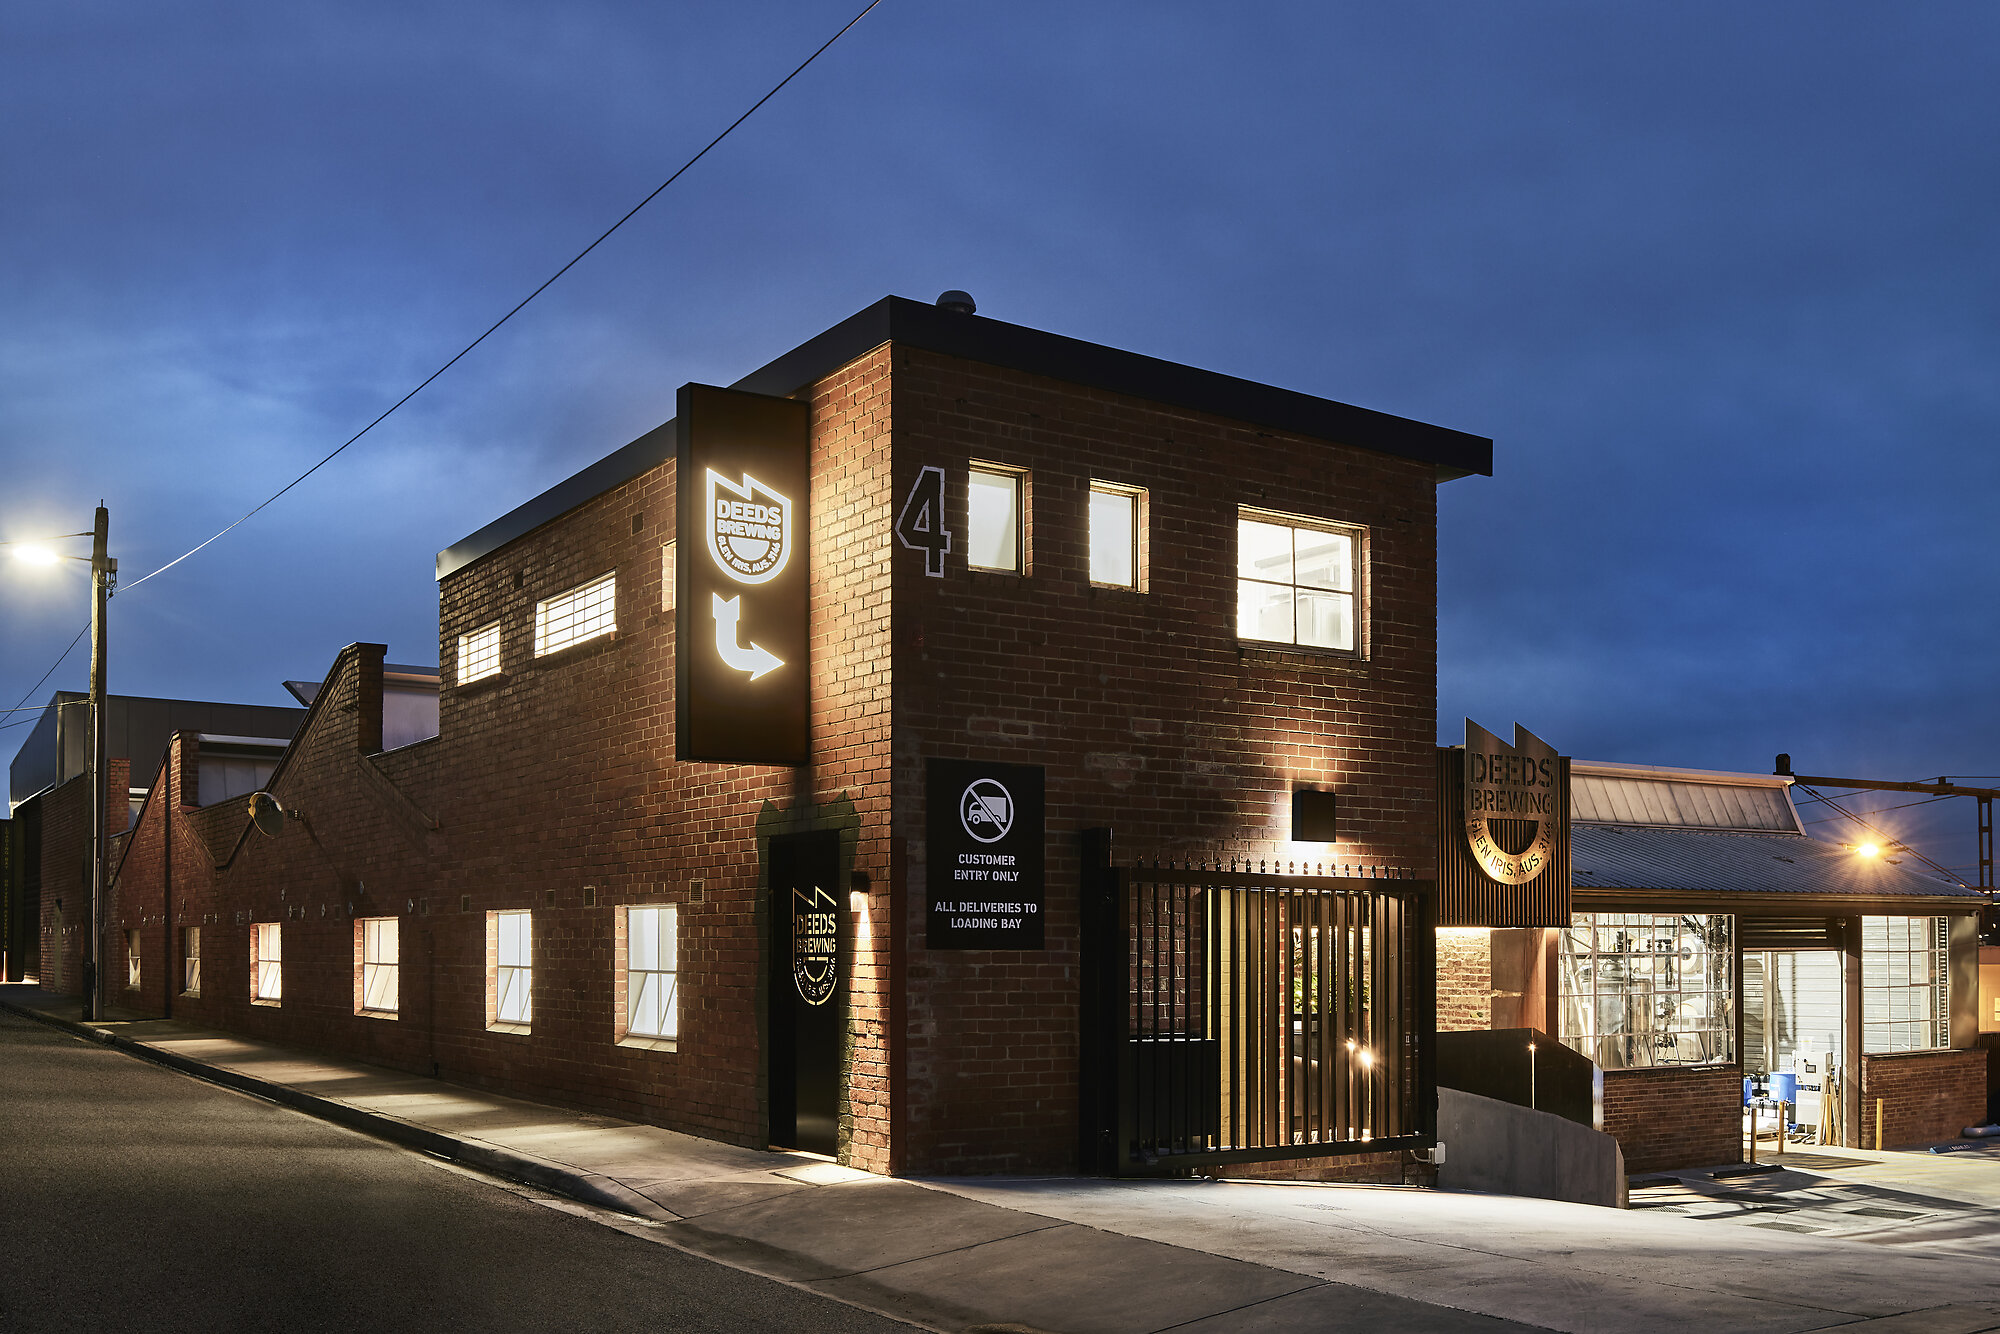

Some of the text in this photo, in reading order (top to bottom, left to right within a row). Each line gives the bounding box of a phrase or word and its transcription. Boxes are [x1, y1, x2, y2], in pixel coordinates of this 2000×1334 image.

[717, 499, 781, 525] DEEDS
[895, 465, 951, 578] 4
[717, 519, 781, 540] BREWING
[718, 535, 733, 561] GLEN
[1471, 753, 1553, 788] DEEDS
[1471, 789, 1553, 815] BREWING
[958, 853, 1016, 866] CUSTOMER
[1471, 818, 1553, 878] GLEN IRIS, AUS. 3146
[954, 869, 1019, 882] ENTRY ONLY
[935, 901, 1037, 913] ALL DELIVERIES TO
[796, 912, 837, 935] DEEDS
[951, 918, 1022, 929] LOADING BAY
[796, 938, 836, 953] BREWING
